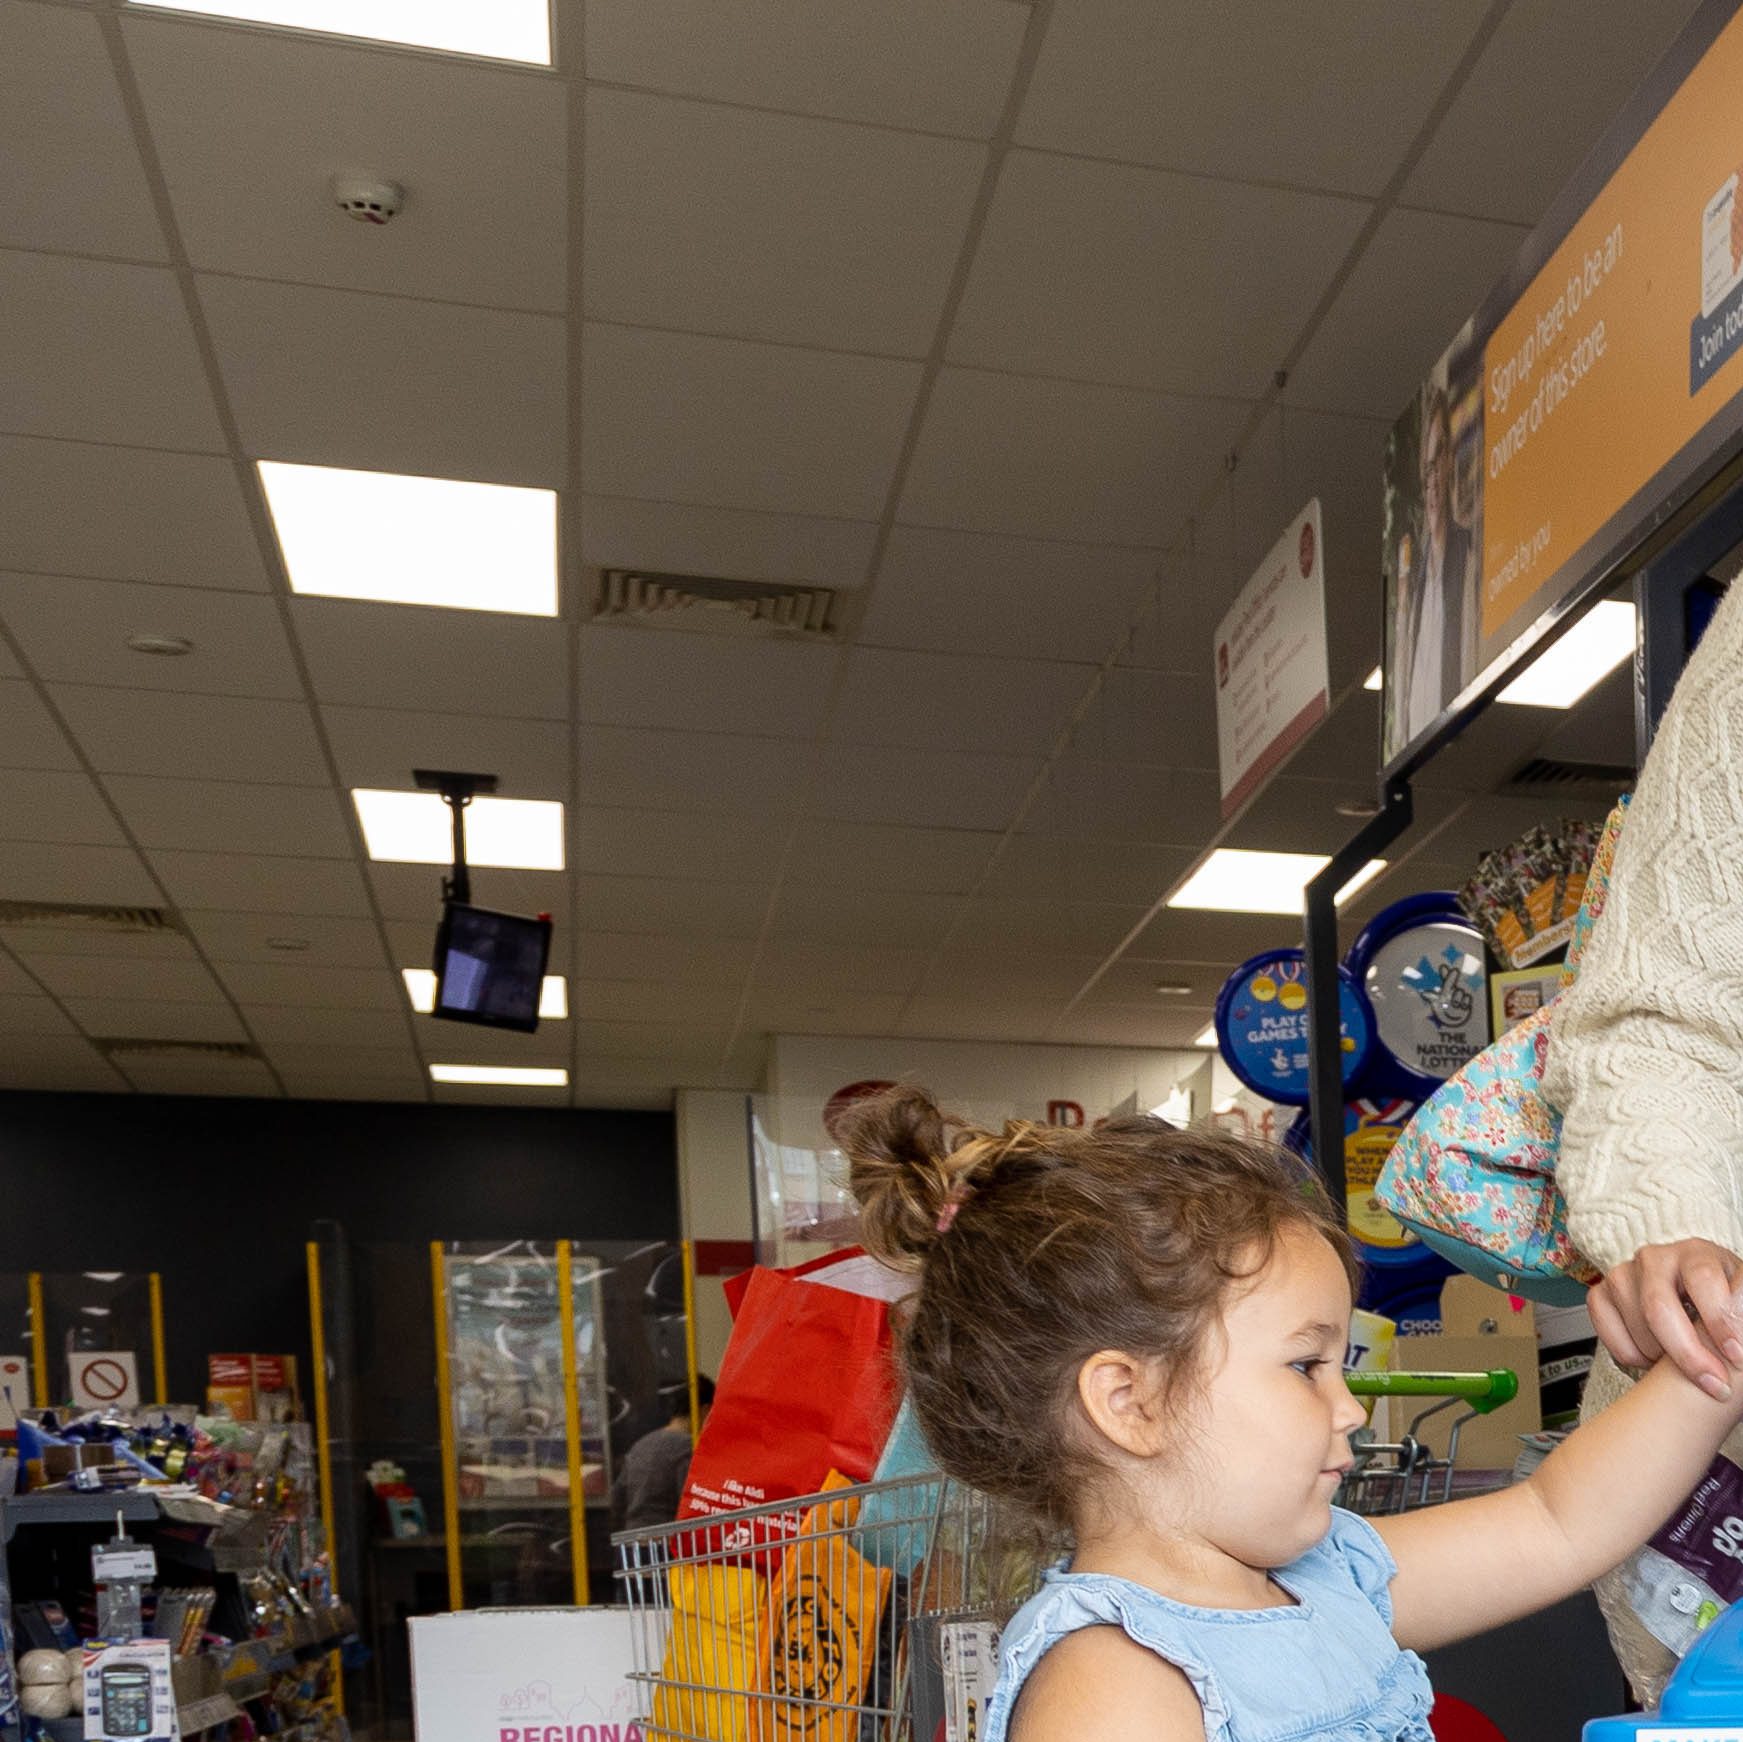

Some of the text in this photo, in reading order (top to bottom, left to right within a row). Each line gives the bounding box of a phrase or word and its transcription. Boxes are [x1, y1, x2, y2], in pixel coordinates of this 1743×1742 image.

[1699, 320, 1724, 368] Join
[1262, 1016, 1298, 1029] PLAY
[1248, 1027, 1297, 1042] GAMES
[1439, 1033, 1467, 1043] THE
